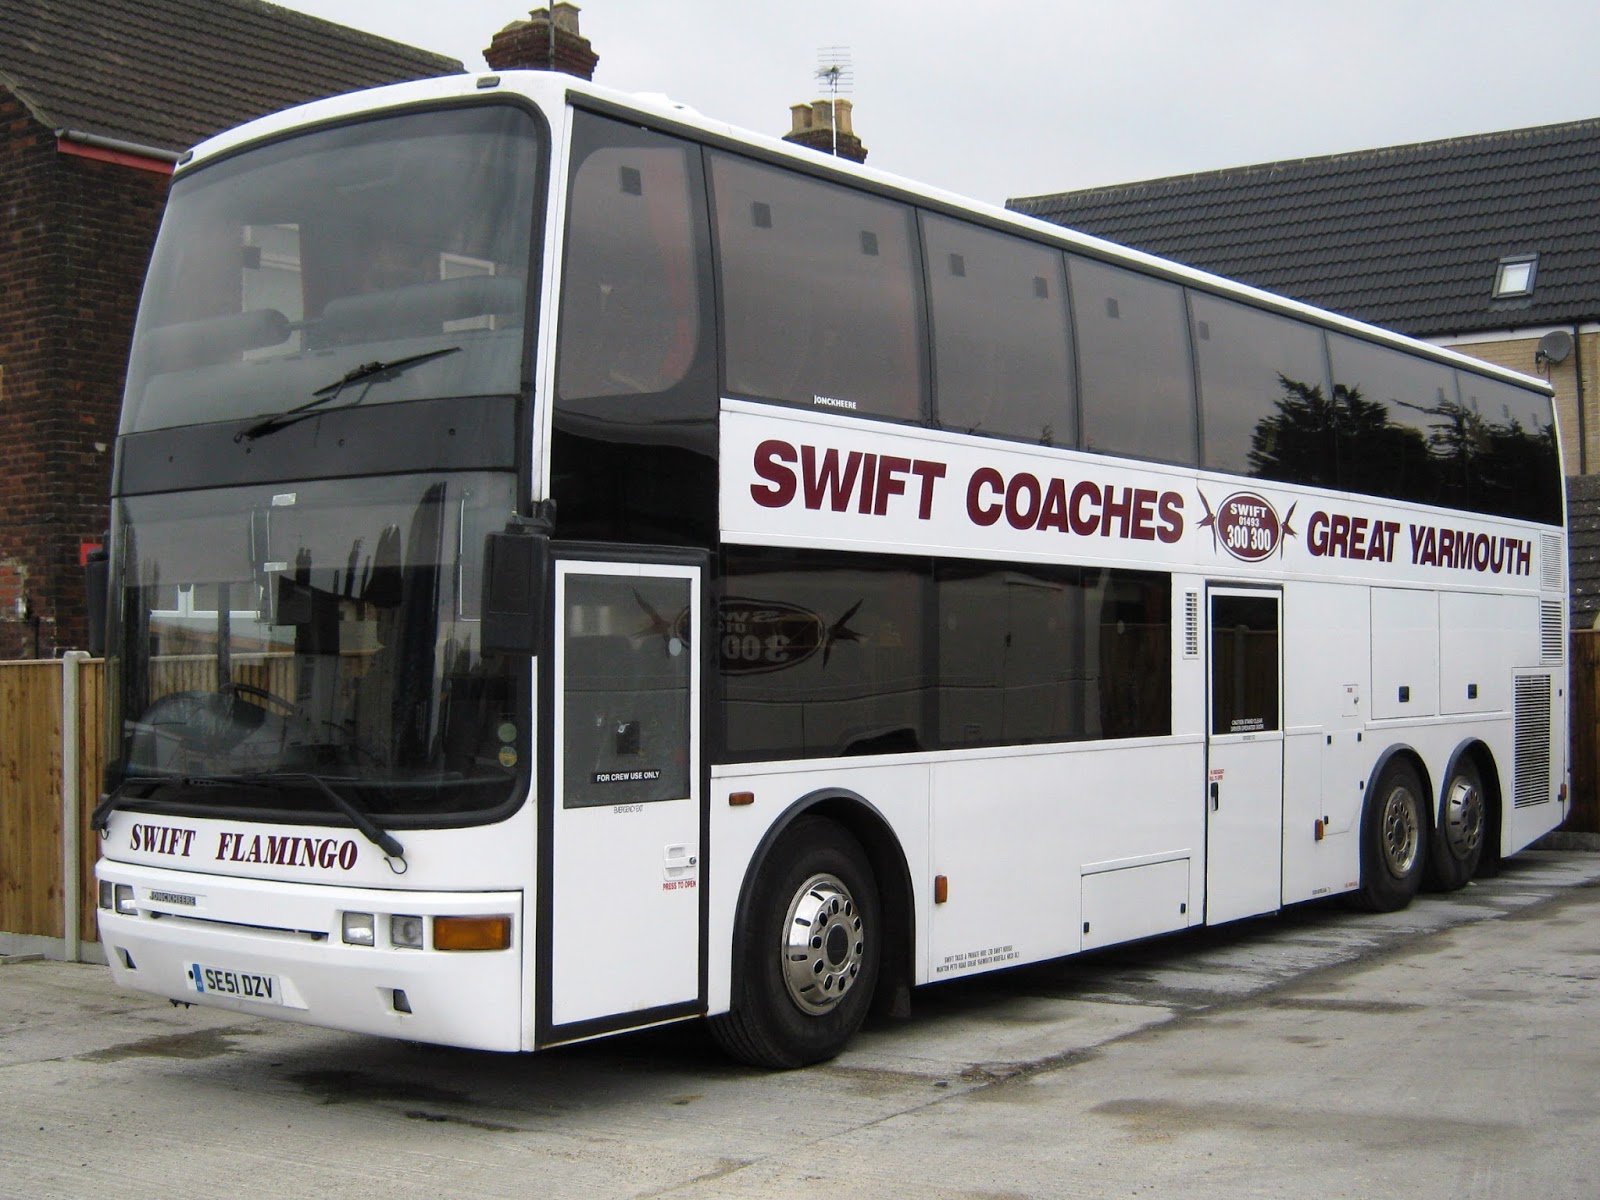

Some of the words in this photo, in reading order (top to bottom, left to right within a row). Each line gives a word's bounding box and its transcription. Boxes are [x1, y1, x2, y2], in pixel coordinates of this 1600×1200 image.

[813, 394, 857, 410] JONCKHEERE
[750, 439, 947, 520] SWIFT
[966, 467, 1184, 544] COACHES
[1230, 503, 1267, 518] SWIFT
[1238, 516, 1260, 527] 01493
[1227, 524, 1248, 549] 300
[1250, 527, 1271, 551] 300
[1307, 511, 1400, 563] GREAT
[1410, 524, 1532, 576] YARMOUTH
[596, 774, 610, 782] FOR
[611, 772, 630, 781] CREW
[630, 771, 643, 780] USE
[643, 771, 660, 779] ONLY
[130, 823, 196, 857] SWIFT
[215, 832, 358, 870] FLAMINGO
[663, 882, 677, 890] PRESS
[678, 881, 684, 889] TO
[685, 880, 697, 888] OPEN
[149, 891, 196, 906] JONCKHEERE
[205, 968, 240, 994] SE51
[241, 974, 273, 998] DZV
